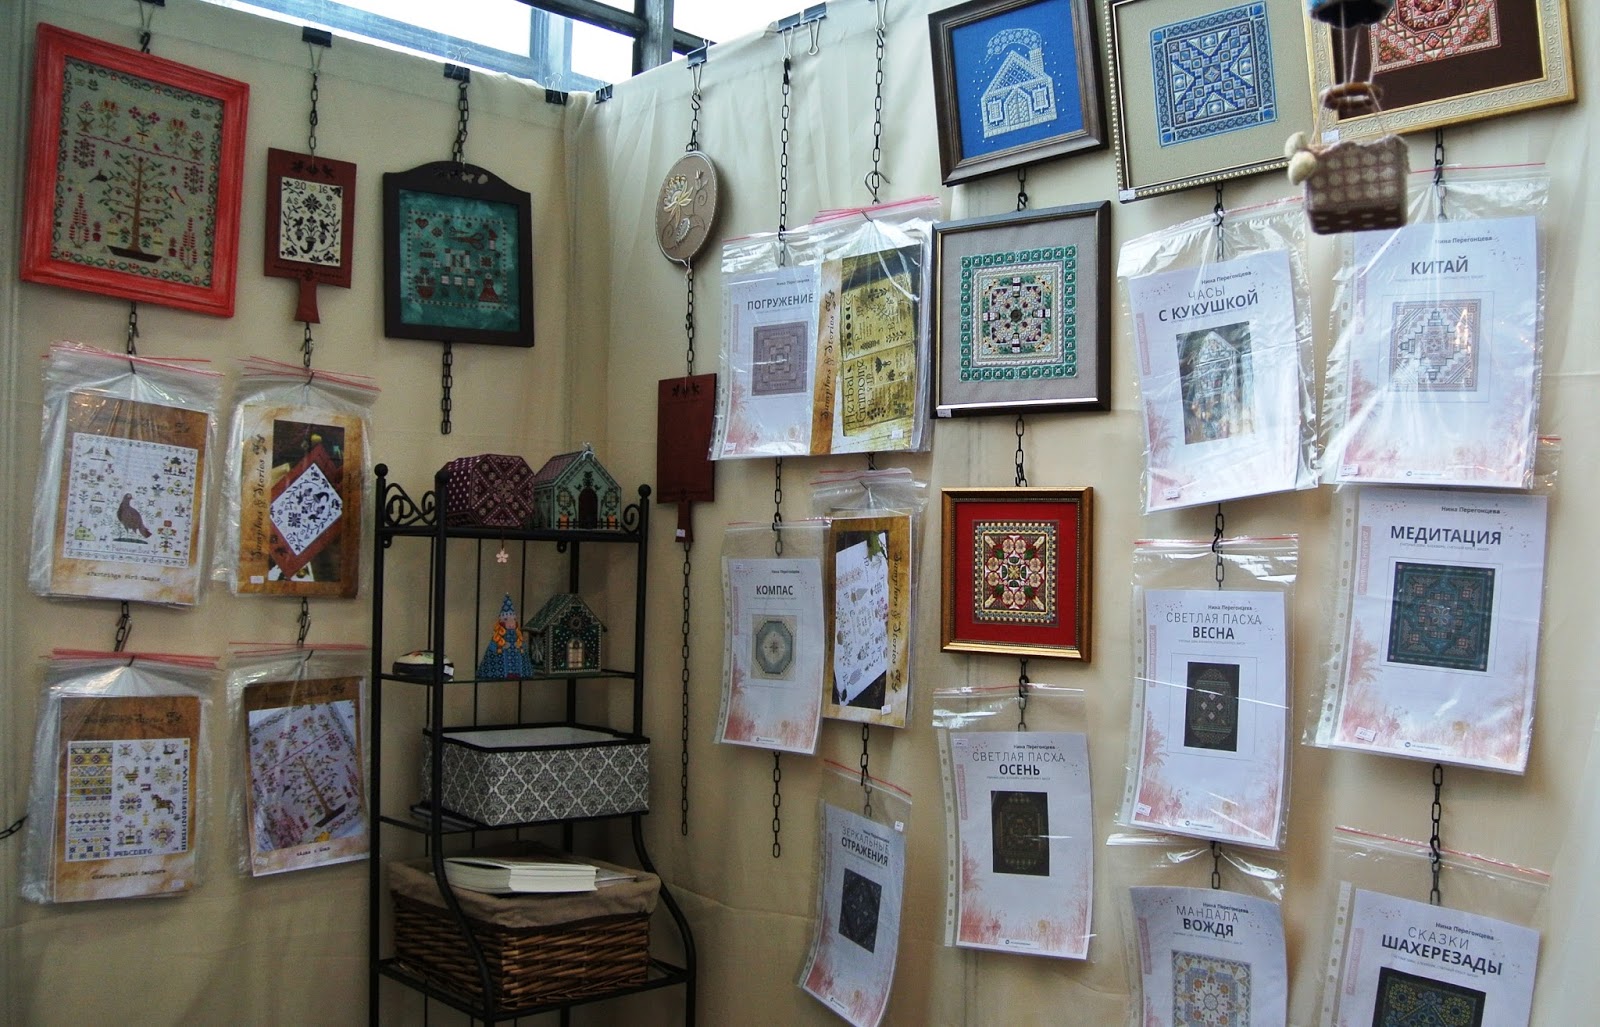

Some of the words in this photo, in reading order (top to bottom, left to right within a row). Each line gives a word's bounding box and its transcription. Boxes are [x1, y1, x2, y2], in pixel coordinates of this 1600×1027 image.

[294, 180, 307, 191] 20
[318, 185, 328, 194] 16
[1411, 255, 1469, 275] КИТАЙ
[747, 293, 814, 311] ПОГРУЖЕНИЕ
[1187, 285, 1226, 301] ЧАСЫ
[1158, 309, 1168, 322] С
[1171, 288, 1260, 320] КУКУШКОЙ
[823, 315, 835, 357] Stories
[845, 376, 856, 425] Herbal
[1390, 525, 1502, 547] МЕДИТАЦИЯ
[756, 585, 794, 596] КОМПАС
[1166, 612, 1219, 624] СВЕТЛАЯ
[1222, 613, 1263, 625] ПАСХА
[1192, 626, 1235, 640] ВЕСНА
[972, 751, 1024, 762] СВЕТЛАЯ
[1028, 752, 1066, 763] ПАСХА
[999, 764, 1041, 776] ОСЕНЬ
[842, 826, 890, 856] ЗЕРКАЛЬНЫЕ
[841, 837, 889, 867] ОТРАЖЕНИЯ
[1176, 905, 1239, 924] МАНДАЛА
[1183, 918, 1234, 939] ВОЖДЯ
[1408, 926, 1470, 951] СКАЗКИ
[1381, 934, 1503, 976] ШАХЕРЕЗАДЫ
